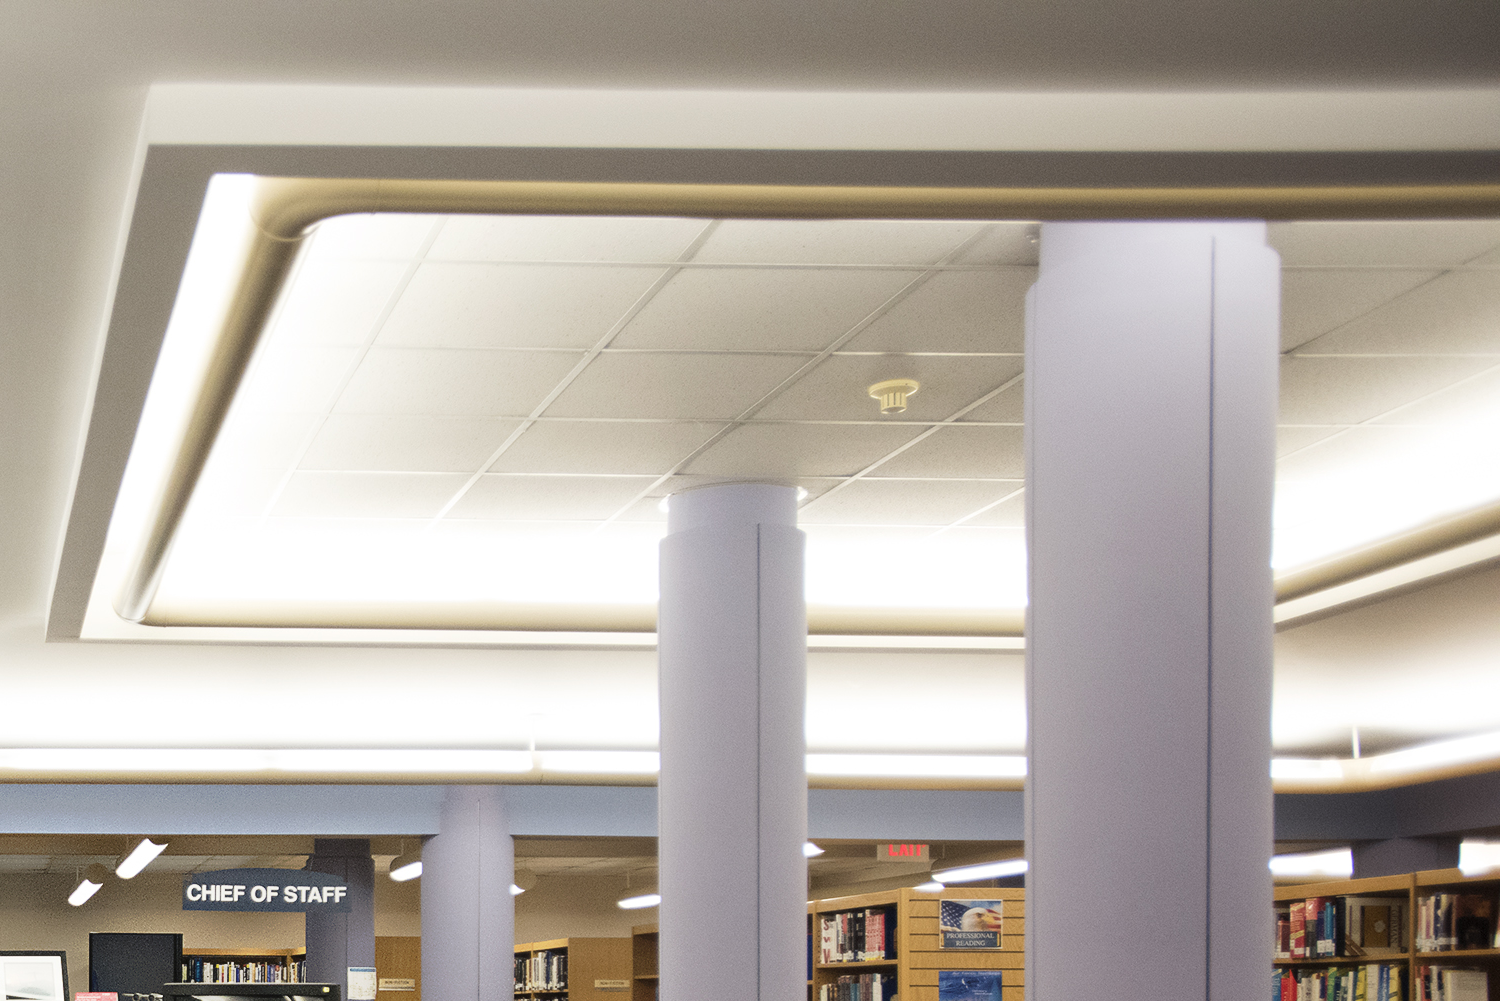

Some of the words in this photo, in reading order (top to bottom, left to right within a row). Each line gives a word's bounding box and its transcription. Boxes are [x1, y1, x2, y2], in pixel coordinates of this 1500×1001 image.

[186, 884, 246, 901] CHIEF
[250, 886, 279, 903] OF
[283, 886, 347, 903] STAFF
